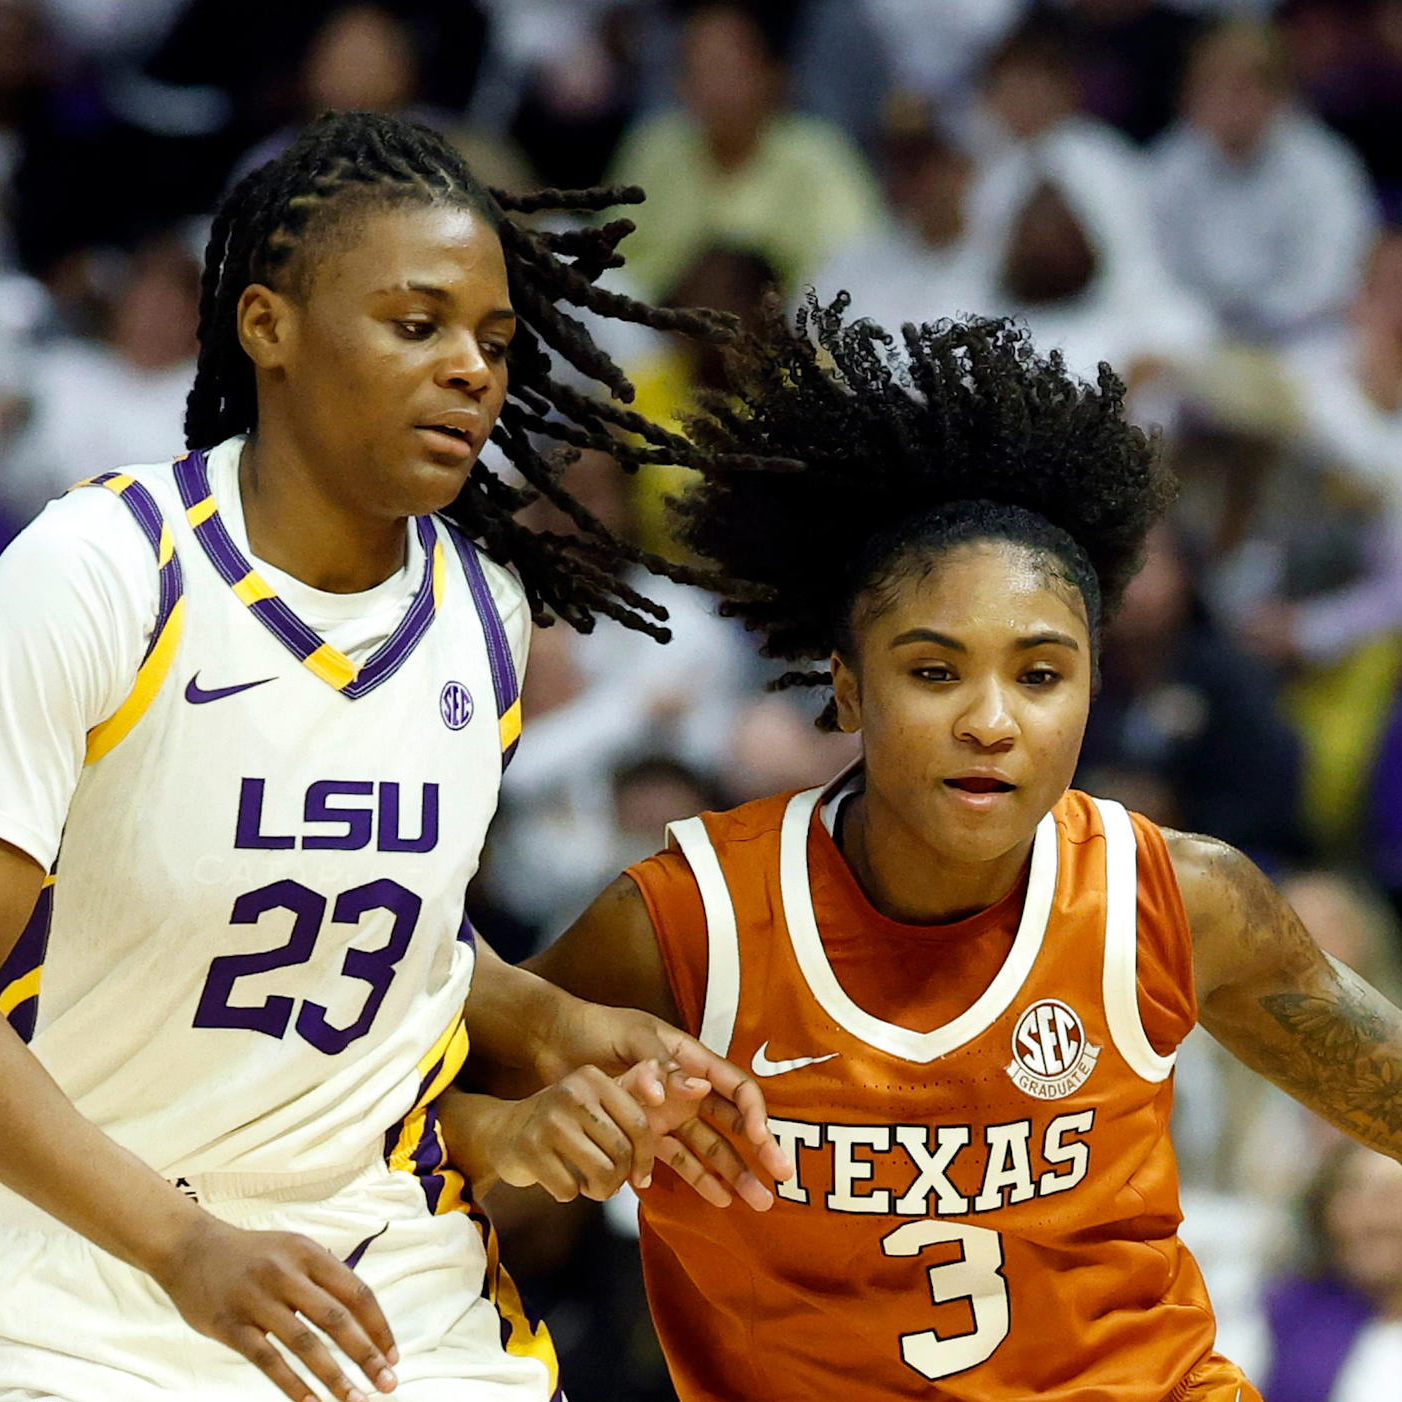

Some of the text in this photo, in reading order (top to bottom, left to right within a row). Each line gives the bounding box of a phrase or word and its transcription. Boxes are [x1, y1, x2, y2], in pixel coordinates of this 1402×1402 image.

[443, 685, 470, 726] SEC
[234, 777, 439, 853] LSU
[192, 878, 422, 1056] 23
[1018, 1005, 1078, 1075] SEC
[1019, 1062, 1091, 1098] GRADUATE
[766, 1108, 1096, 1216] TEXAS
[881, 1217, 1011, 1380] 3
